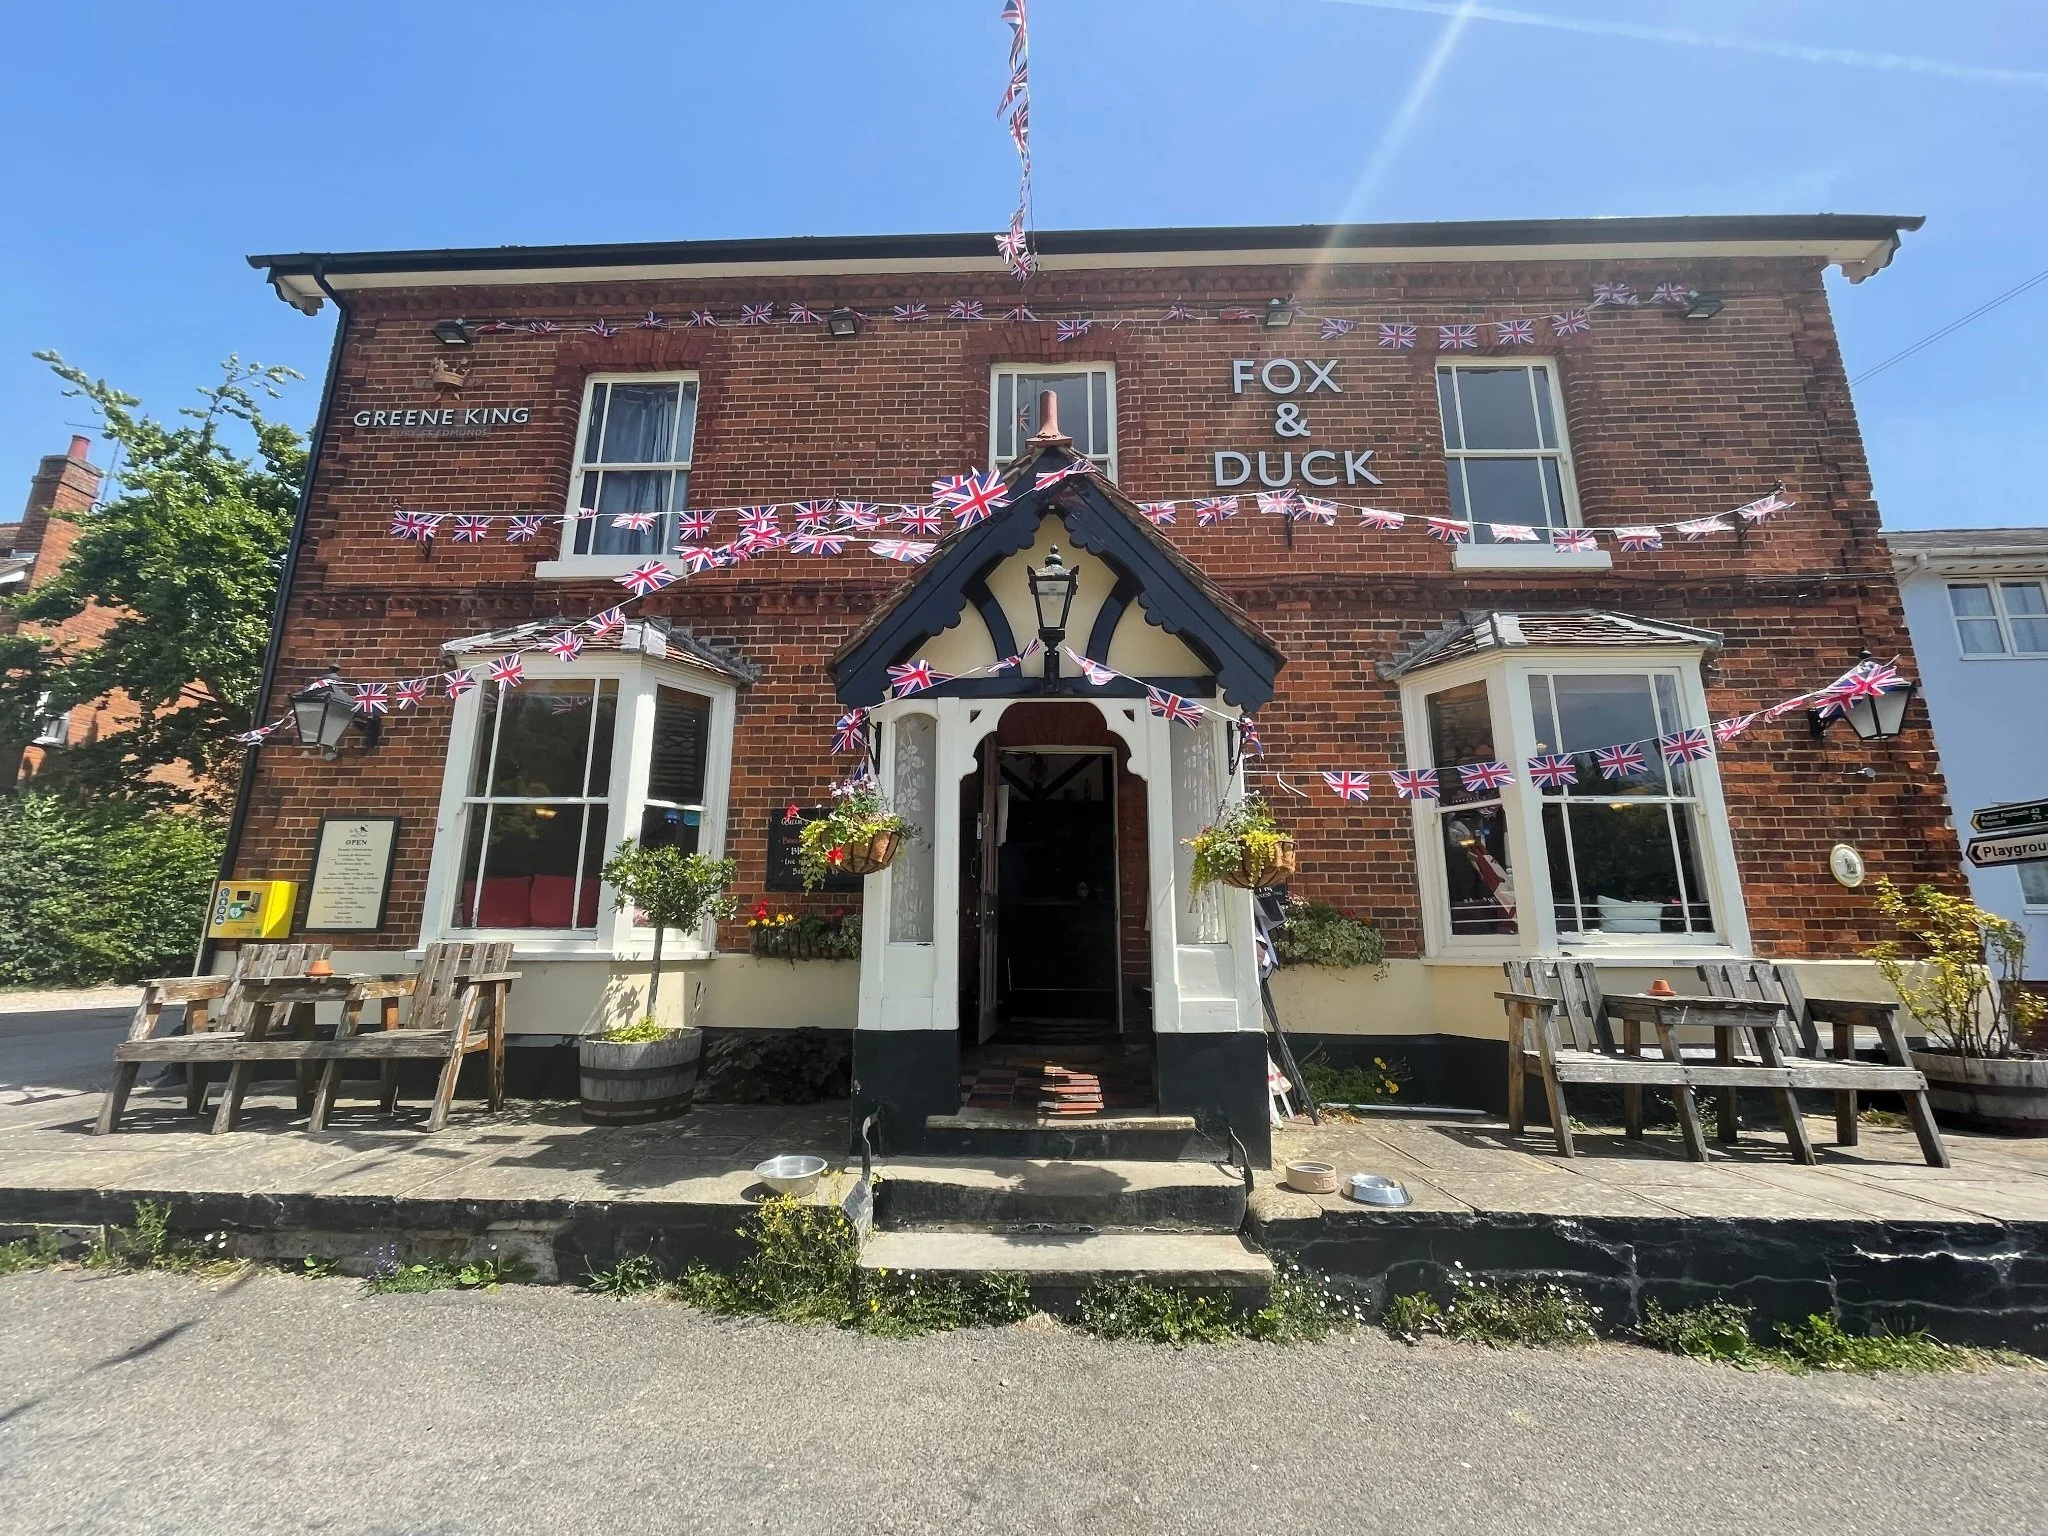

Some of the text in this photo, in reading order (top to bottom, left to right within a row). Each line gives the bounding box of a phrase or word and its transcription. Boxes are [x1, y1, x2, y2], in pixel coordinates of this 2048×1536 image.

[1232, 358, 1343, 395] FOX
[353, 407, 530, 427] GREENE KING
[1274, 402, 1311, 438] &
[437, 429, 489, 437] EDMUNDS
[1214, 449, 1384, 487] DUCK
[1983, 841, 2048, 857] Playgrou
